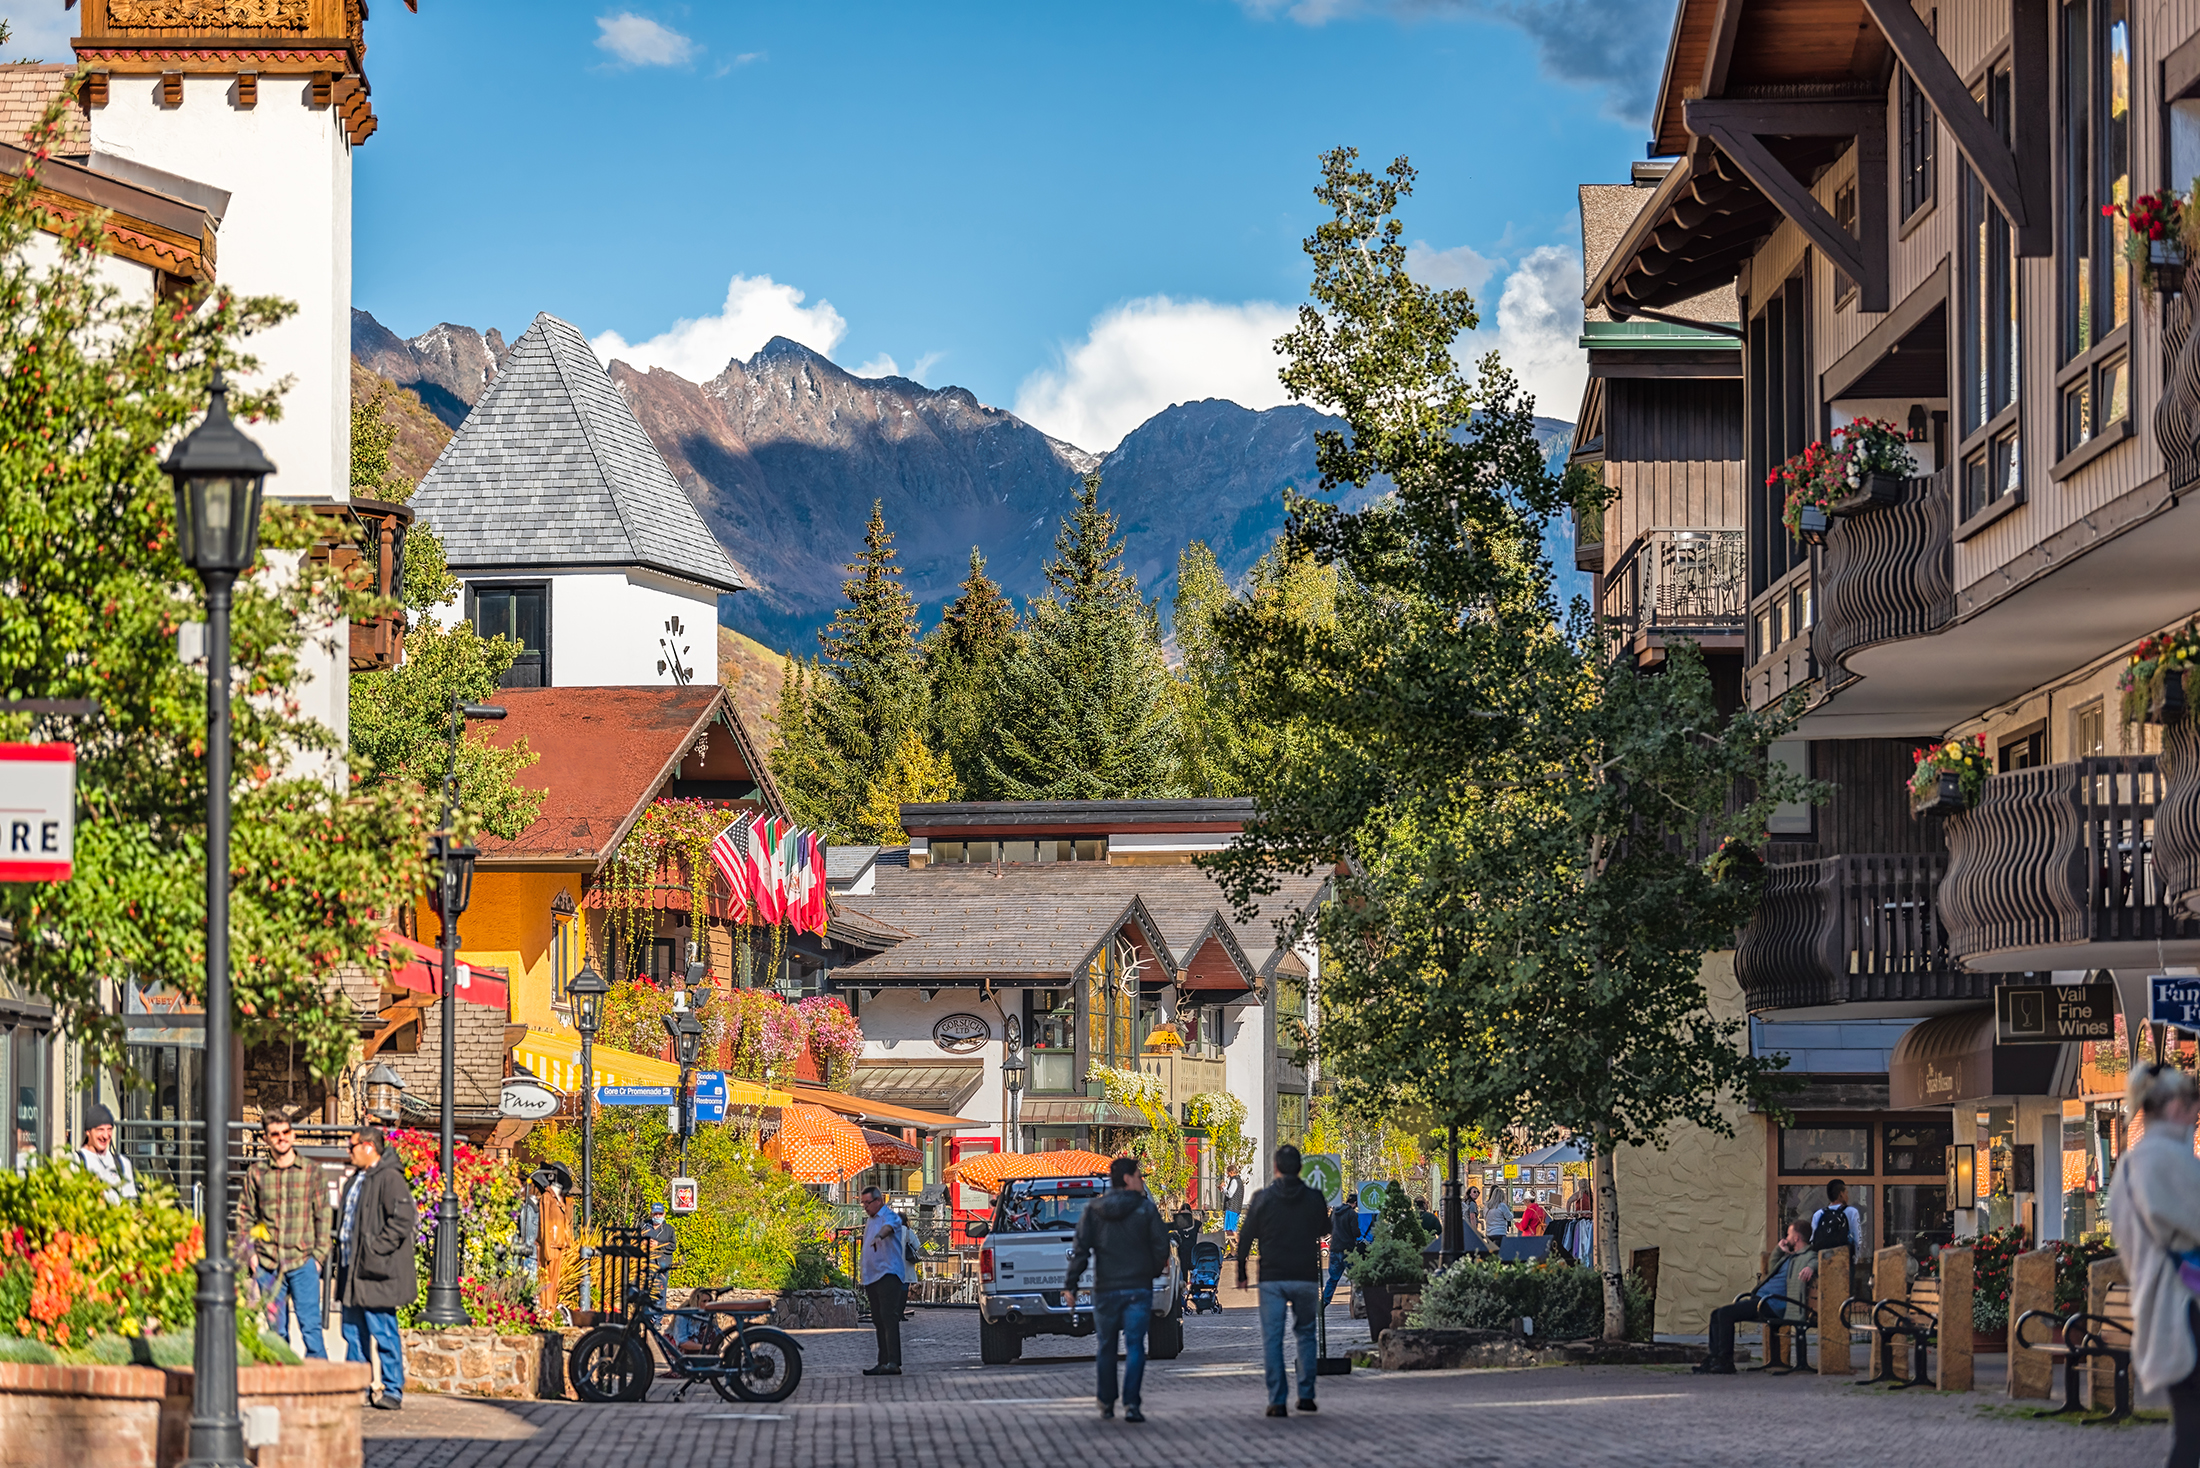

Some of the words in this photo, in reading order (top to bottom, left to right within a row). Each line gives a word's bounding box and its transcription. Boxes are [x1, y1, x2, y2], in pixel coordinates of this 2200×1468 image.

[0, 821, 60, 853] RE
[2056, 986, 2087, 1002] Vail
[2058, 1003, 2093, 1019] Fine
[941, 1019, 983, 1033] GORSUCH
[2058, 1020, 2109, 1036] Wines
[503, 1091, 547, 1108] Pano
[603, 1087, 618, 1095] Gore
[619, 1087, 627, 1095] Cr
[627, 1087, 662, 1096] Promenade
[695, 1097, 723, 1105] Restrooms
